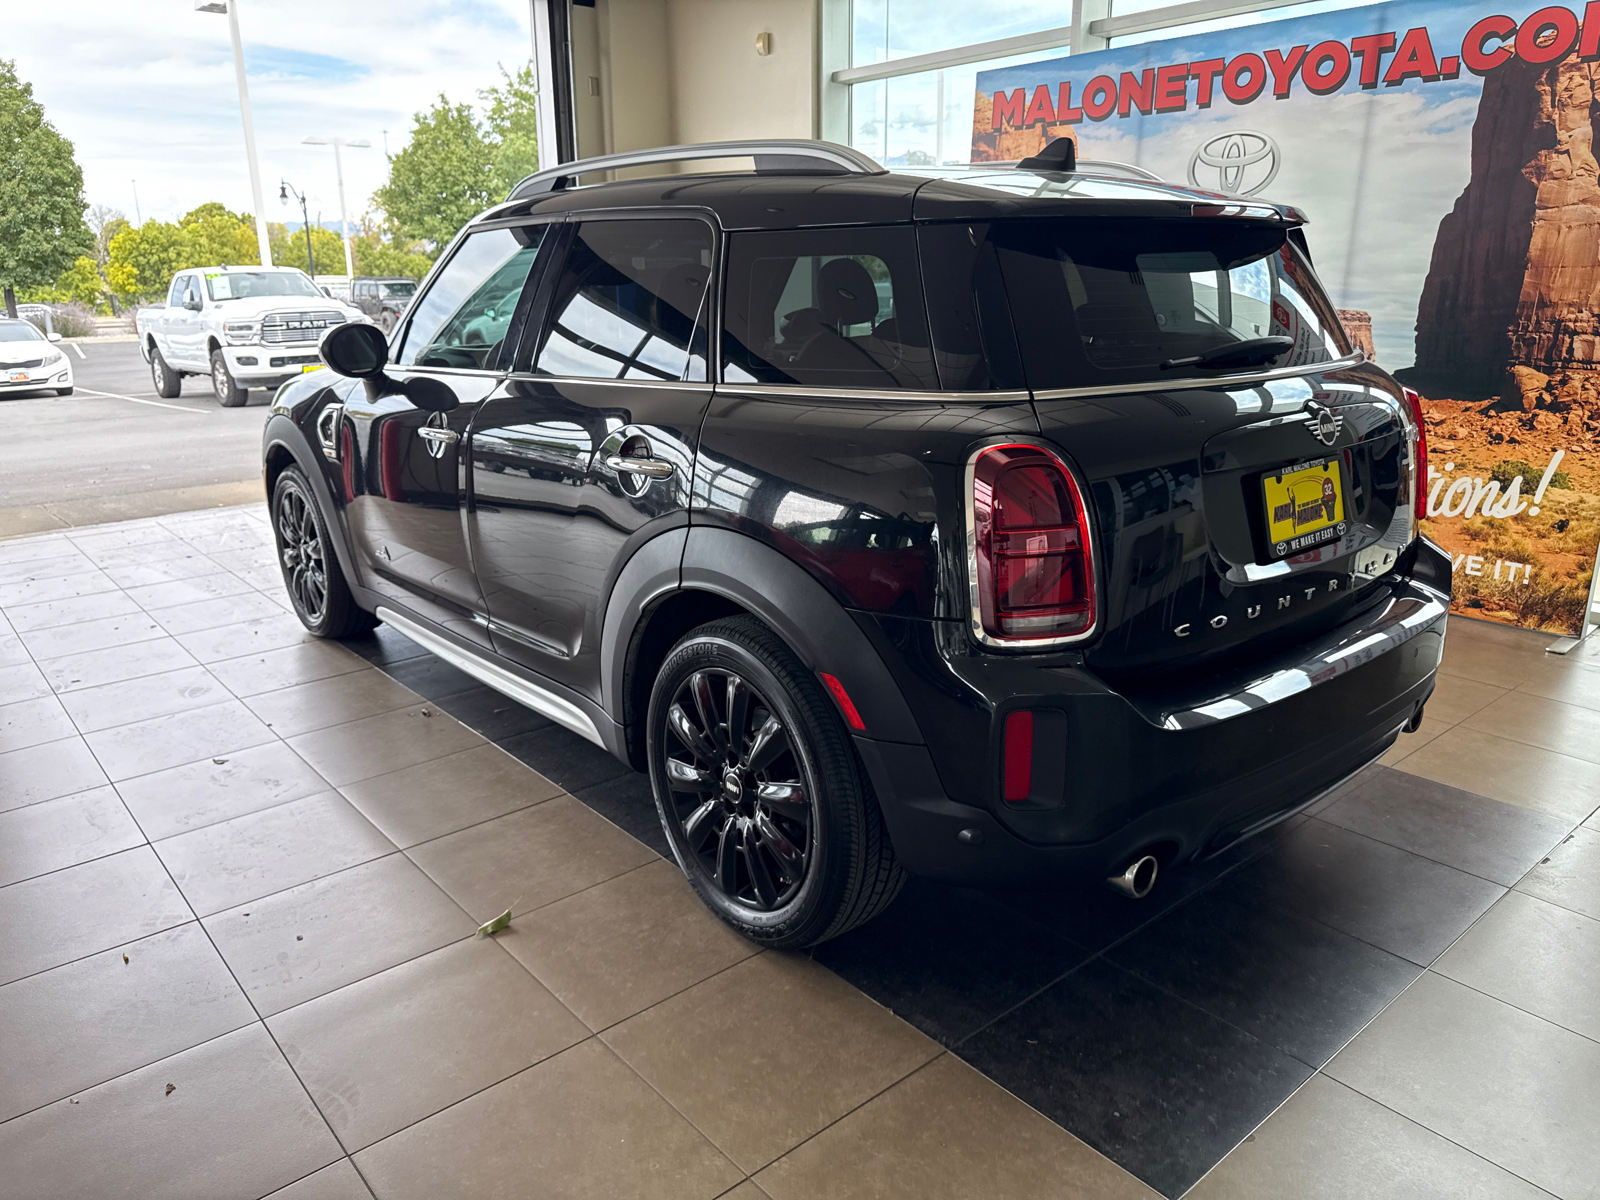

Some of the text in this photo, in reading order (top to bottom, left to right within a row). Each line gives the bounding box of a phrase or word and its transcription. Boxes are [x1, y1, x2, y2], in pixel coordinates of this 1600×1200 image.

[288, 320, 326, 330] RAM
[1310, 458, 1326, 468] TOYOTA
[1324, 483, 1333, 496] 32
[1291, 527, 1334, 550] WE MAKE IT EASY
[1493, 559, 1532, 585] IT!
